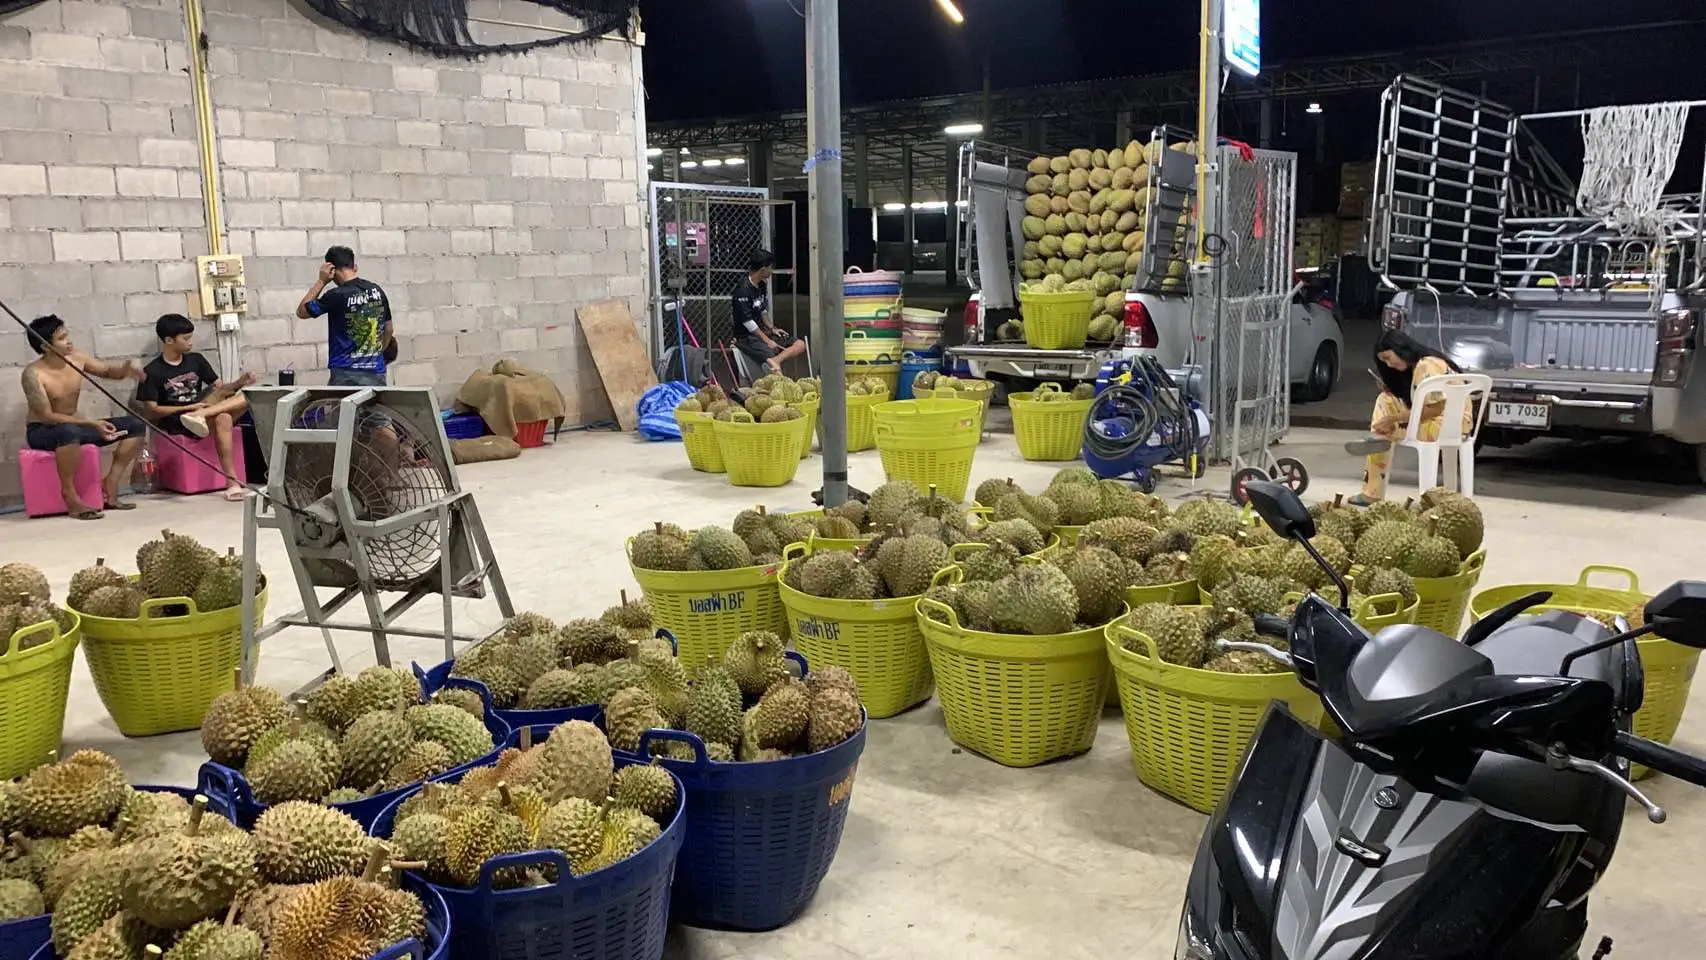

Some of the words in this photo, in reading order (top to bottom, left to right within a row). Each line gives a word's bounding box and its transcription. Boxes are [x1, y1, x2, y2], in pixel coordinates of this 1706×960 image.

[1517, 404, 1546, 417] 7032
[728, 590, 745, 610] BF
[823, 621, 841, 640] BF
